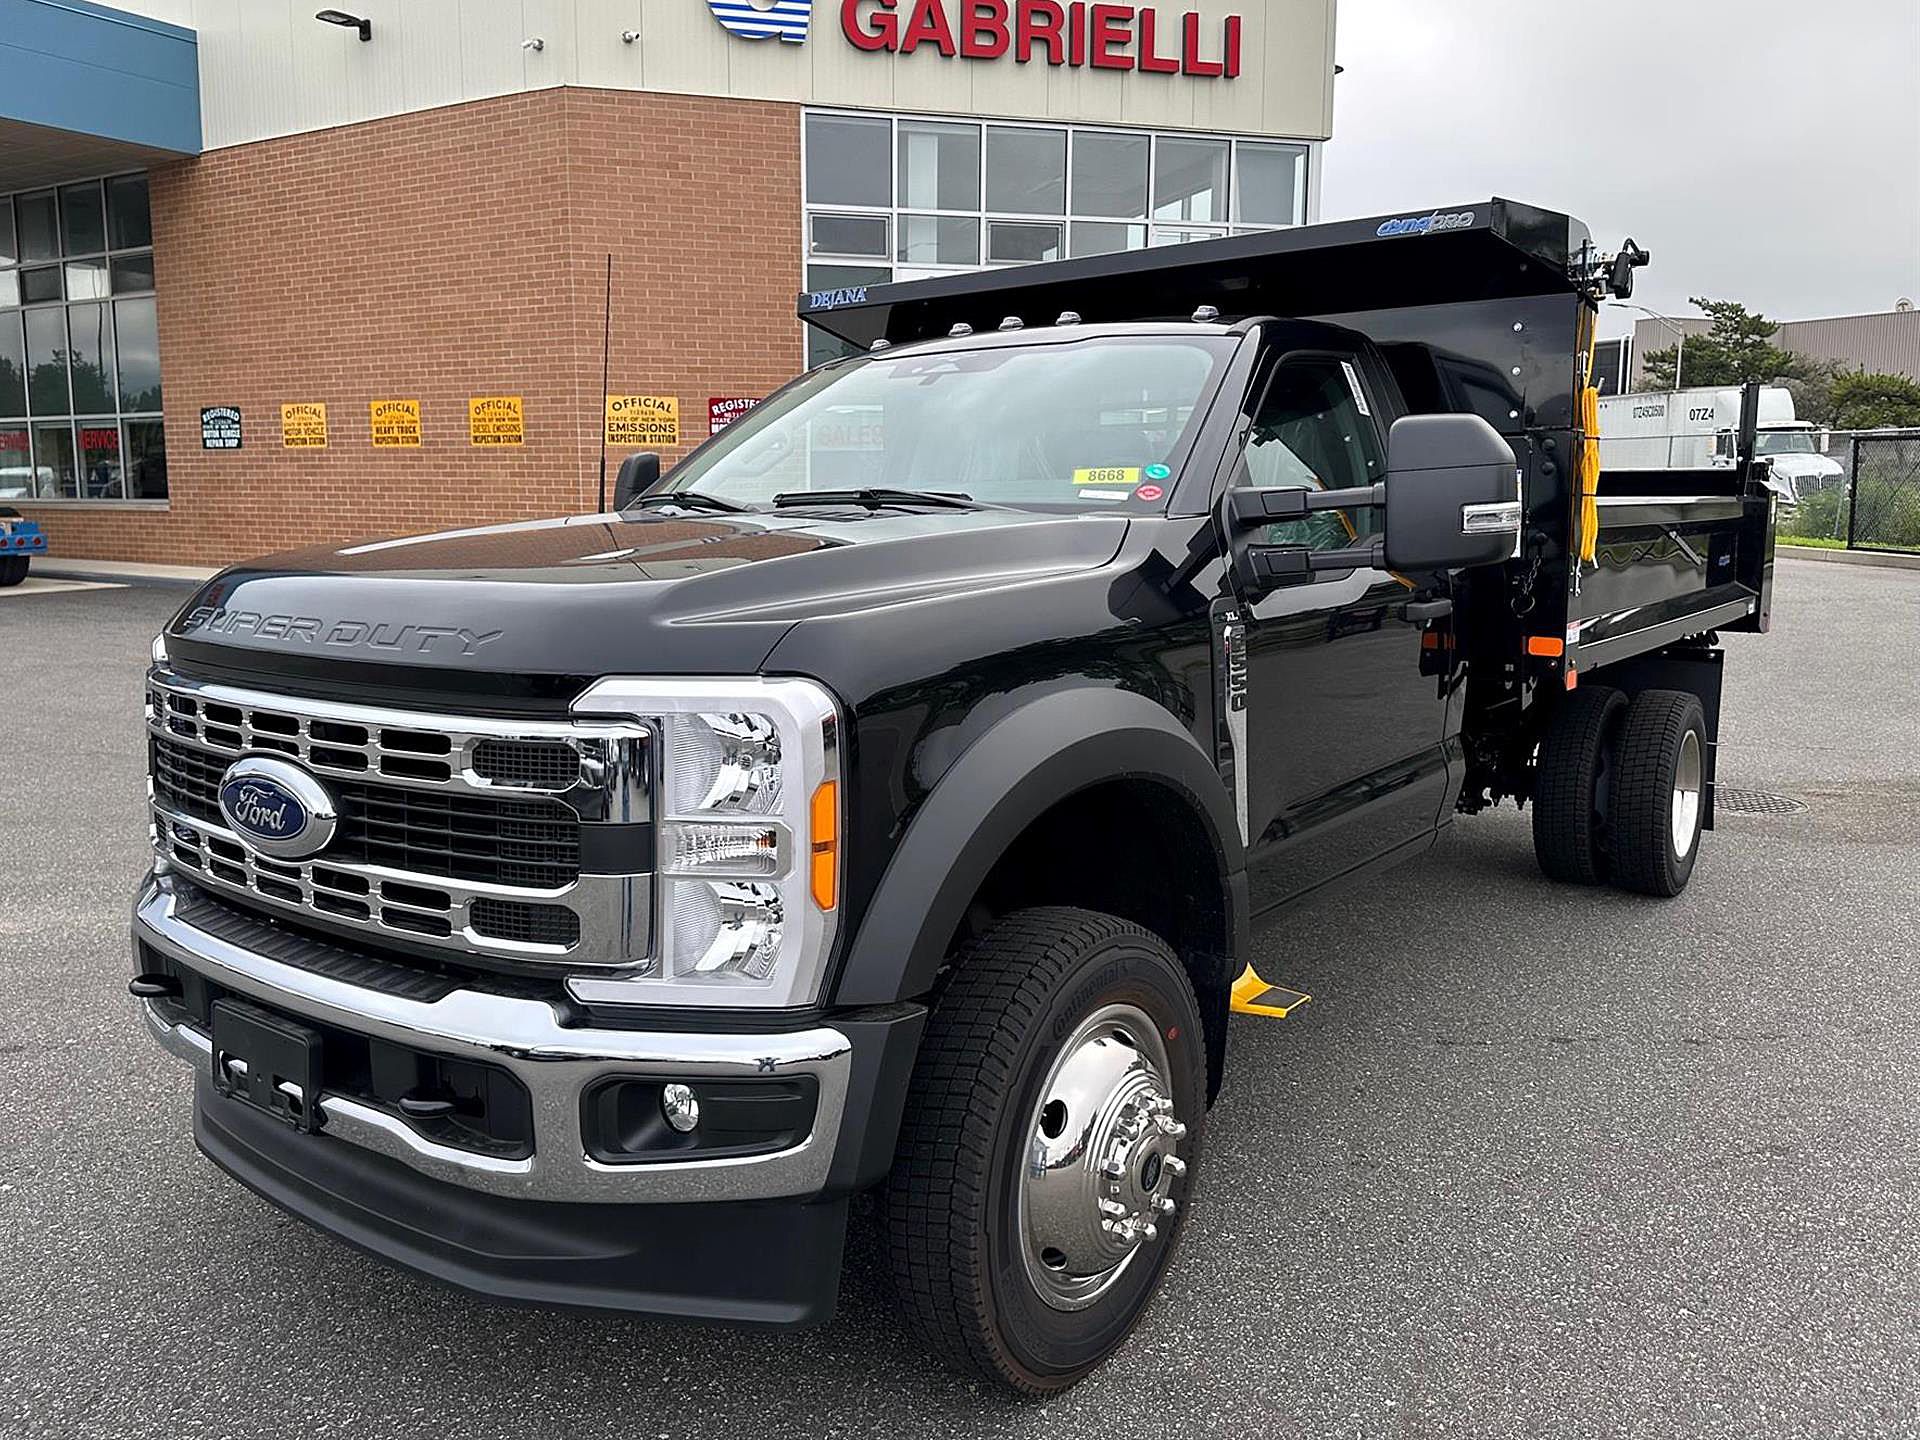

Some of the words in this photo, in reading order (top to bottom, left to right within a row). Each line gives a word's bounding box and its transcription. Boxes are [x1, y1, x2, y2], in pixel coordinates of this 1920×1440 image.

[841, 0, 1242, 78] GABRIELLI
[810, 287, 867, 309] DEJANA
[375, 402, 416, 417] OFFICIAL
[474, 400, 518, 415] OFFICIAL
[612, 397, 672, 414] OFFICIAL
[711, 398, 760, 416] REGISTE
[203, 407, 239, 422] REGISTERED
[286, 406, 321, 419] OFFICIAL
[1689, 408, 1714, 421] 07Z4
[304, 427, 324, 436] VEHICLE
[375, 426, 394, 435] HEAVY
[396, 425, 416, 434] TRUCK
[473, 424, 490, 433] DIESEL
[493, 423, 521, 433] EMISSIONS
[608, 423, 676, 433] EMISSIONS
[374, 436, 399, 445] INSPECTION
[401, 436, 419, 444] STATION
[473, 435, 500, 444] INSPECTION
[502, 435, 522, 443] STATION
[608, 433, 647, 443] INSPECTION
[649, 434, 676, 443] STATION
[1088, 469, 1125, 481] 8668
[184, 606, 324, 643] SUPER
[326, 621, 505, 656] DUTY
[234, 784, 287, 832] Ford
